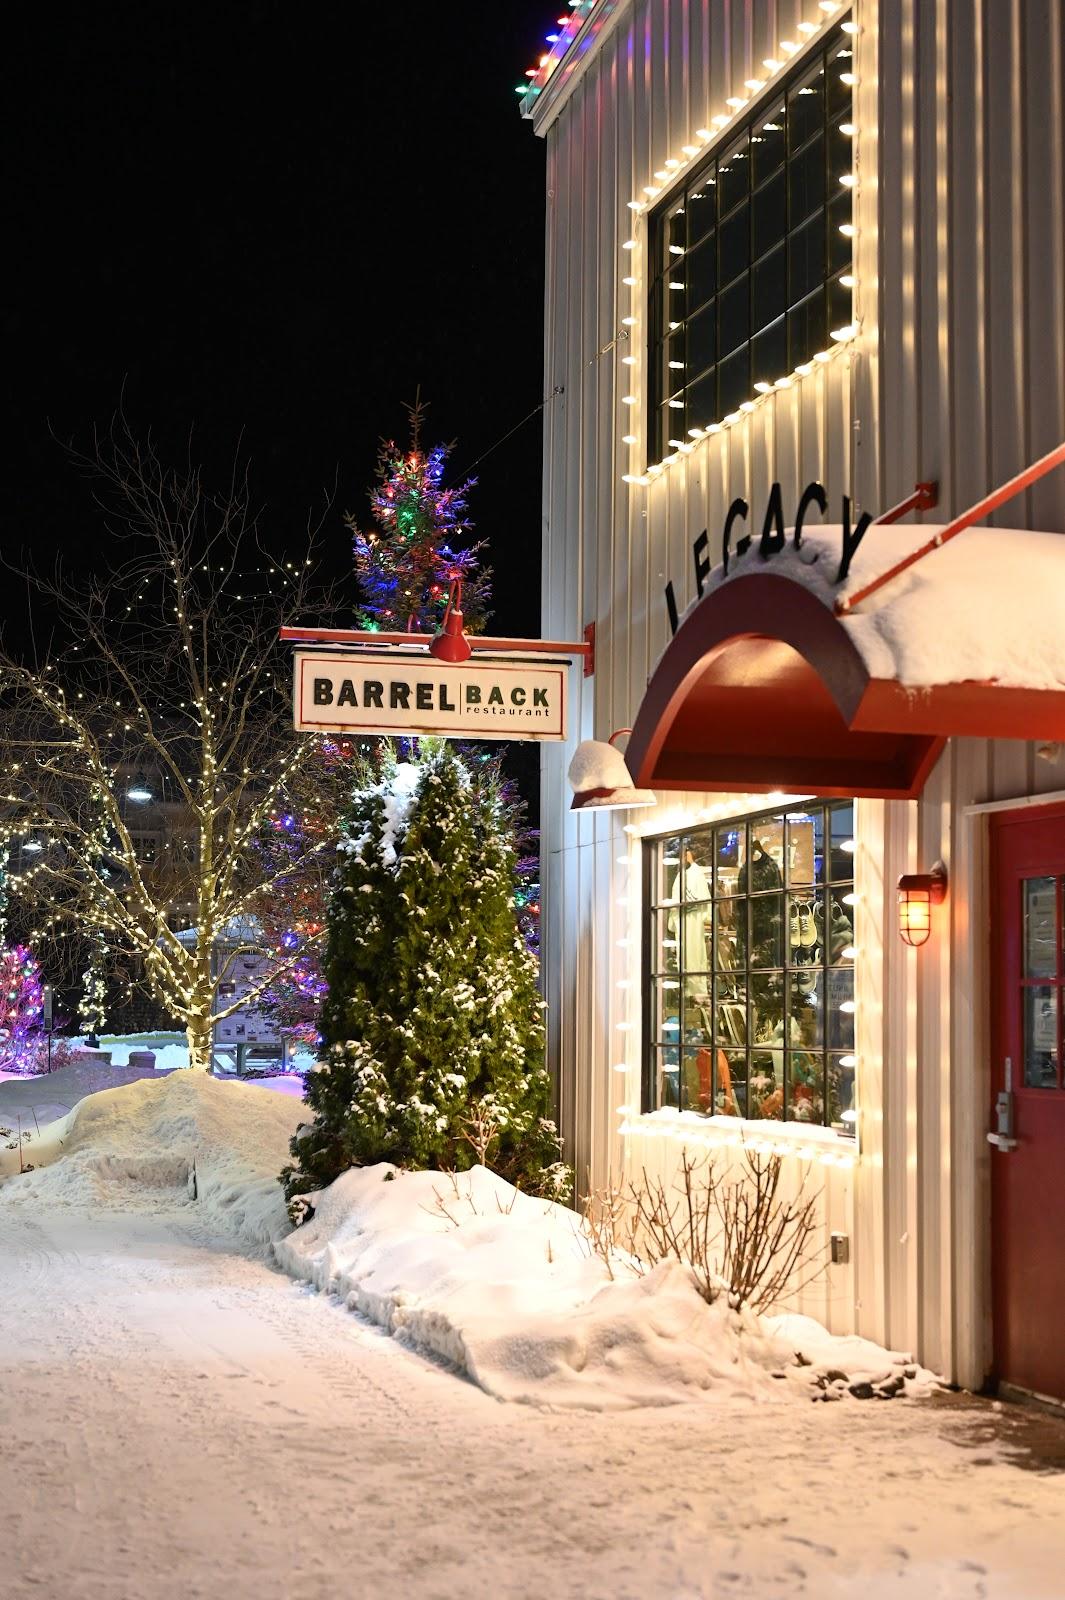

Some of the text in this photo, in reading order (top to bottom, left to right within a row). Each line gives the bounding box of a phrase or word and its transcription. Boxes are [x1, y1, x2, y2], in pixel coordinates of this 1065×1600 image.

[313, 678, 549, 711] BARREL BACK
[466, 706, 549, 717] restaurant
